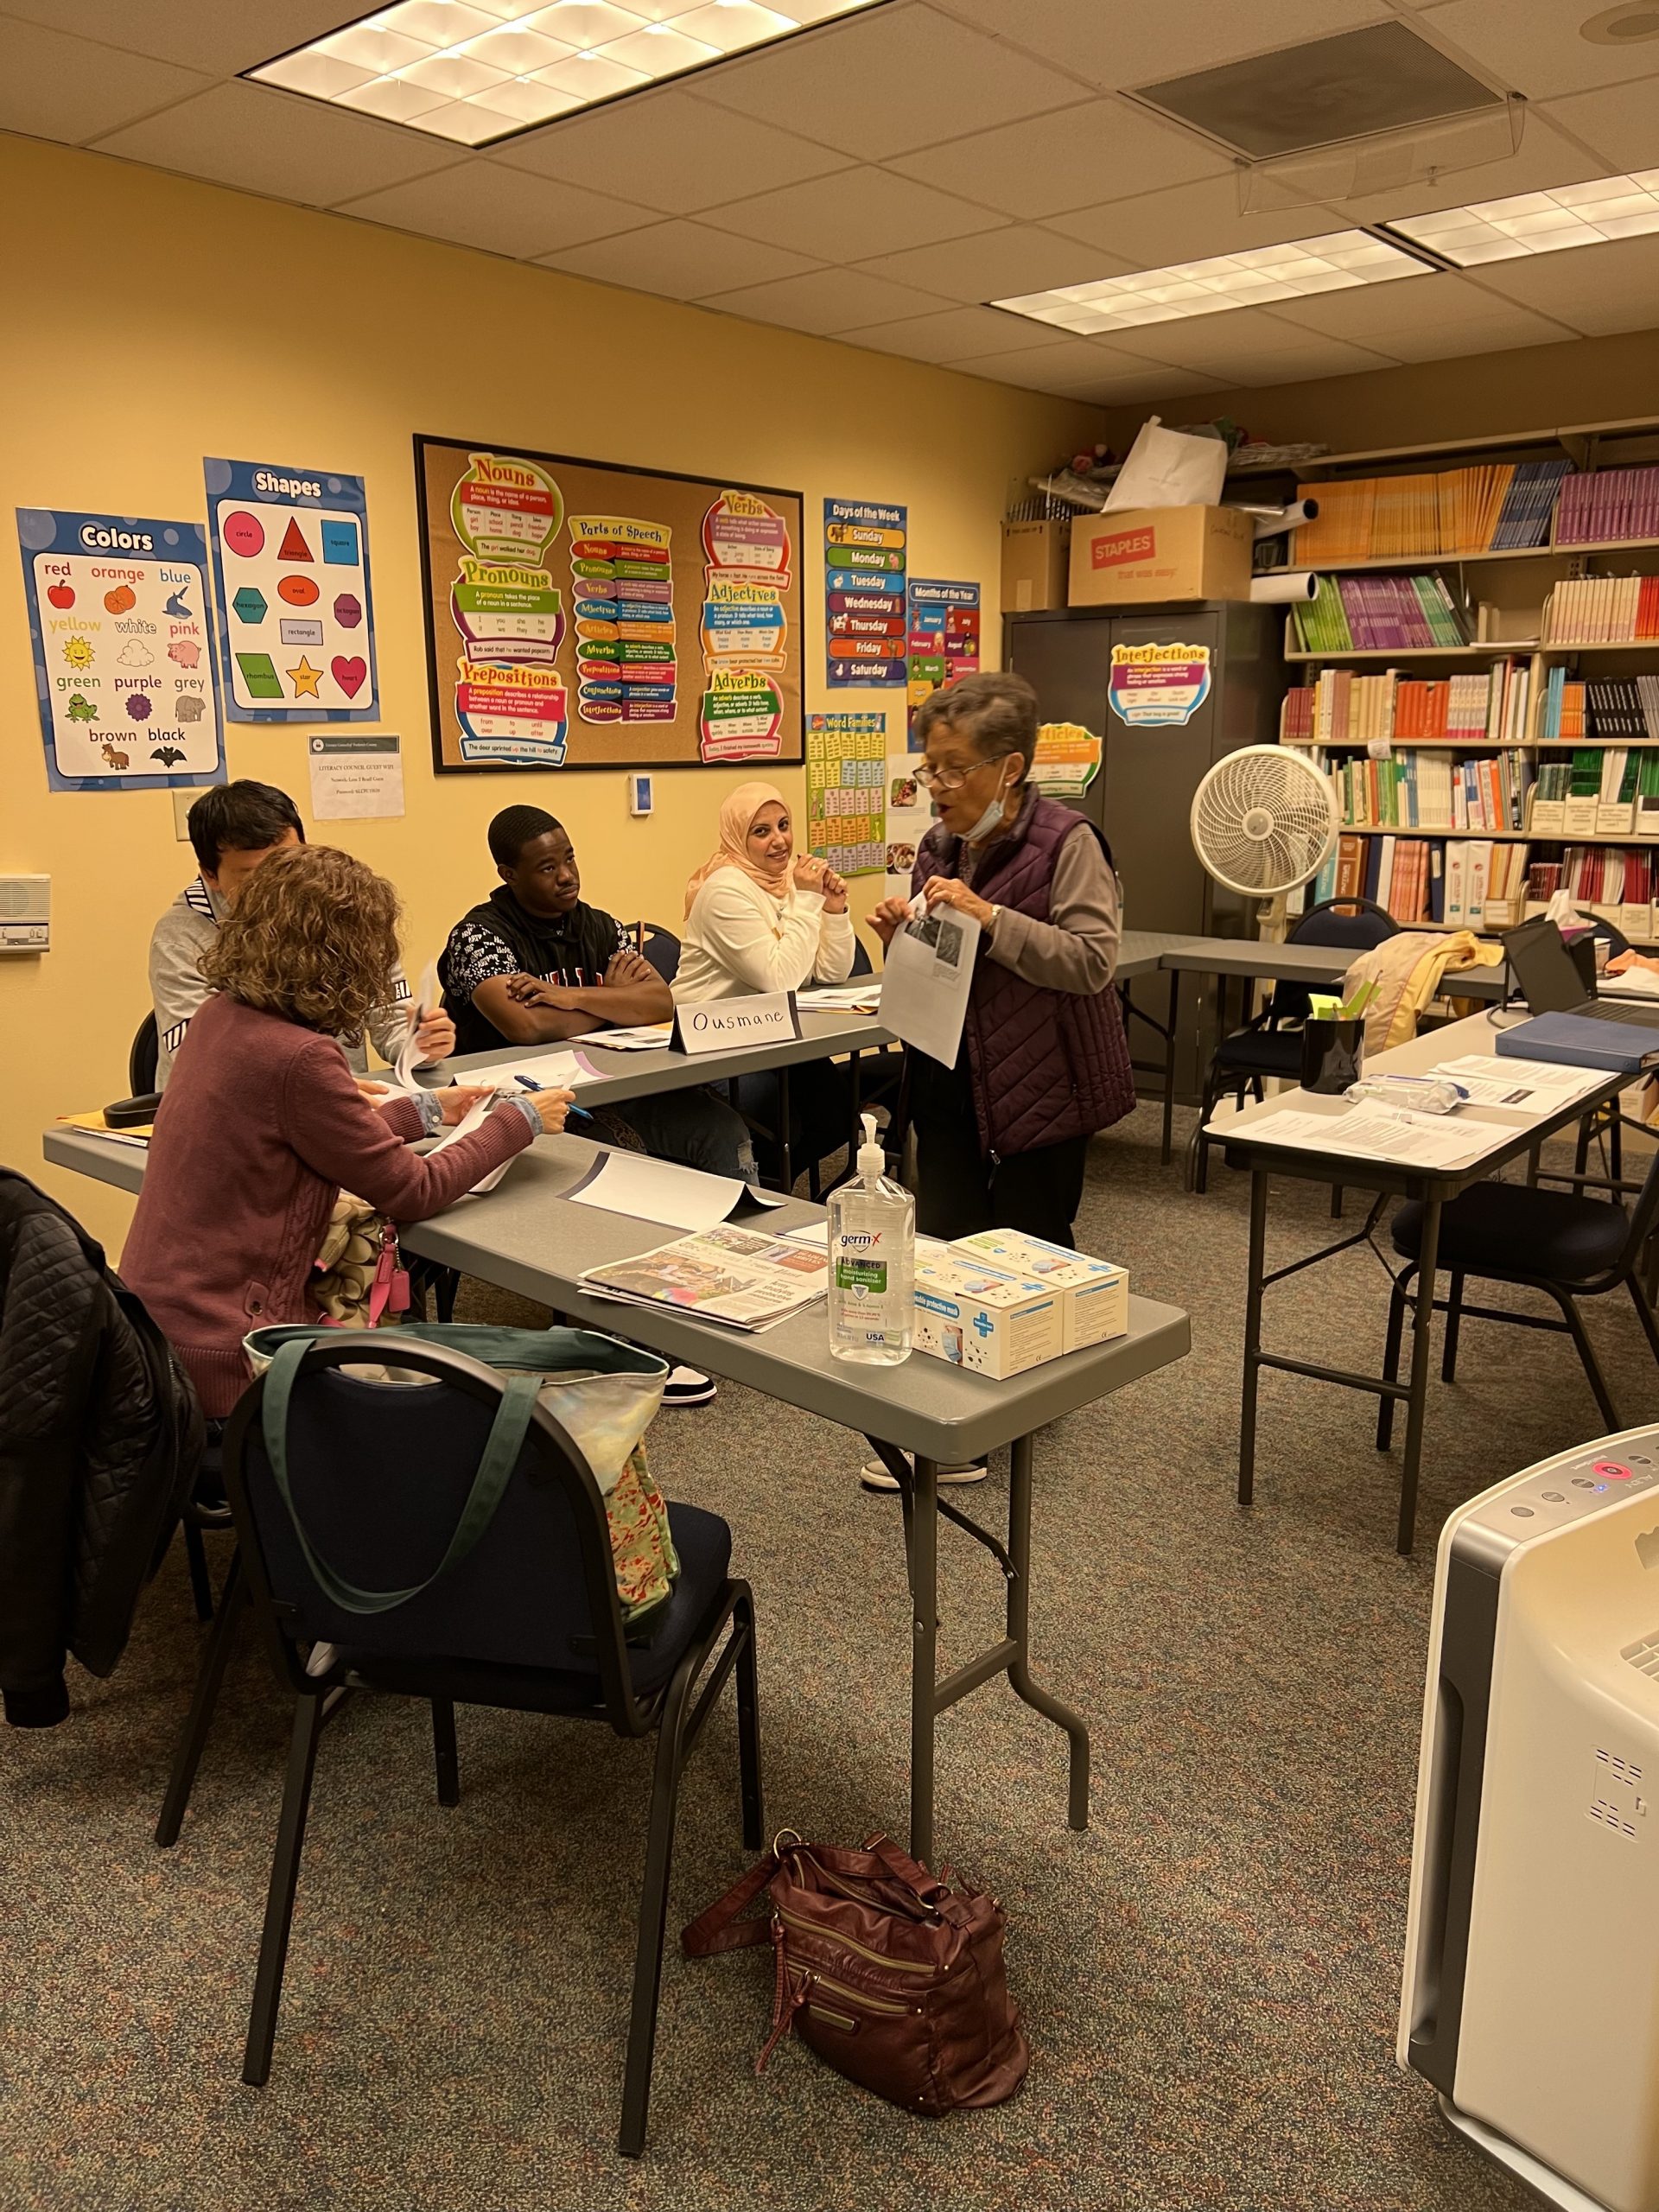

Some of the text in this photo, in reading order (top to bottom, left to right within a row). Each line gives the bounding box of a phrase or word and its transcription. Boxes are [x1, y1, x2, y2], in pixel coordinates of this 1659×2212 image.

[475, 459, 534, 486] Nouns
[255, 471, 321, 499] Shapes
[725, 495, 763, 514] Verbs
[833, 505, 900, 522] Days of the Week
[81, 525, 154, 550] Colors
[580, 522, 662, 543] Parts of Speech
[853, 529, 884, 544] Sunday
[284, 550, 308, 558] triangle
[584, 543, 607, 555] Nouns
[1095, 535, 1152, 560] STAPLES
[851, 552, 885, 567] Monday
[45, 563, 191, 584] red orange blue
[463, 561, 549, 588] Pronouns
[581, 563, 613, 574] Pronouns
[1118, 570, 1134, 580] that
[1136, 569, 1153, 578] was
[586, 583, 607, 594] Verbs
[851, 575, 886, 589] Tuesday
[711, 584, 776, 601] Adjectives
[915, 588, 974, 601] Months of the Year
[582, 603, 615, 614] Adjectives
[844, 596, 893, 613] Wednesday
[49, 617, 200, 638] yellow white pink
[586, 624, 613, 634] Articles
[850, 620, 887, 632] Thursday
[587, 645, 614, 655] Adverbs
[856, 642, 881, 655] Friday
[1116, 648, 1205, 663] Interjections
[582, 664, 620, 674] Prepositions
[850, 664, 887, 680] Saturday
[57, 675, 204, 692] green purple grey
[714, 673, 766, 691] Adverbs
[583, 686, 621, 696] Conjunctions
[583, 706, 621, 715] Interjections
[826, 716, 847, 728] Word
[848, 715, 875, 728] Families
[89, 728, 186, 741] brown black
[693, 1010, 784, 1032] Ousmane
[842, 1256, 880, 1268] ADVANCED
[843, 1268, 878, 1279] moisturizing
